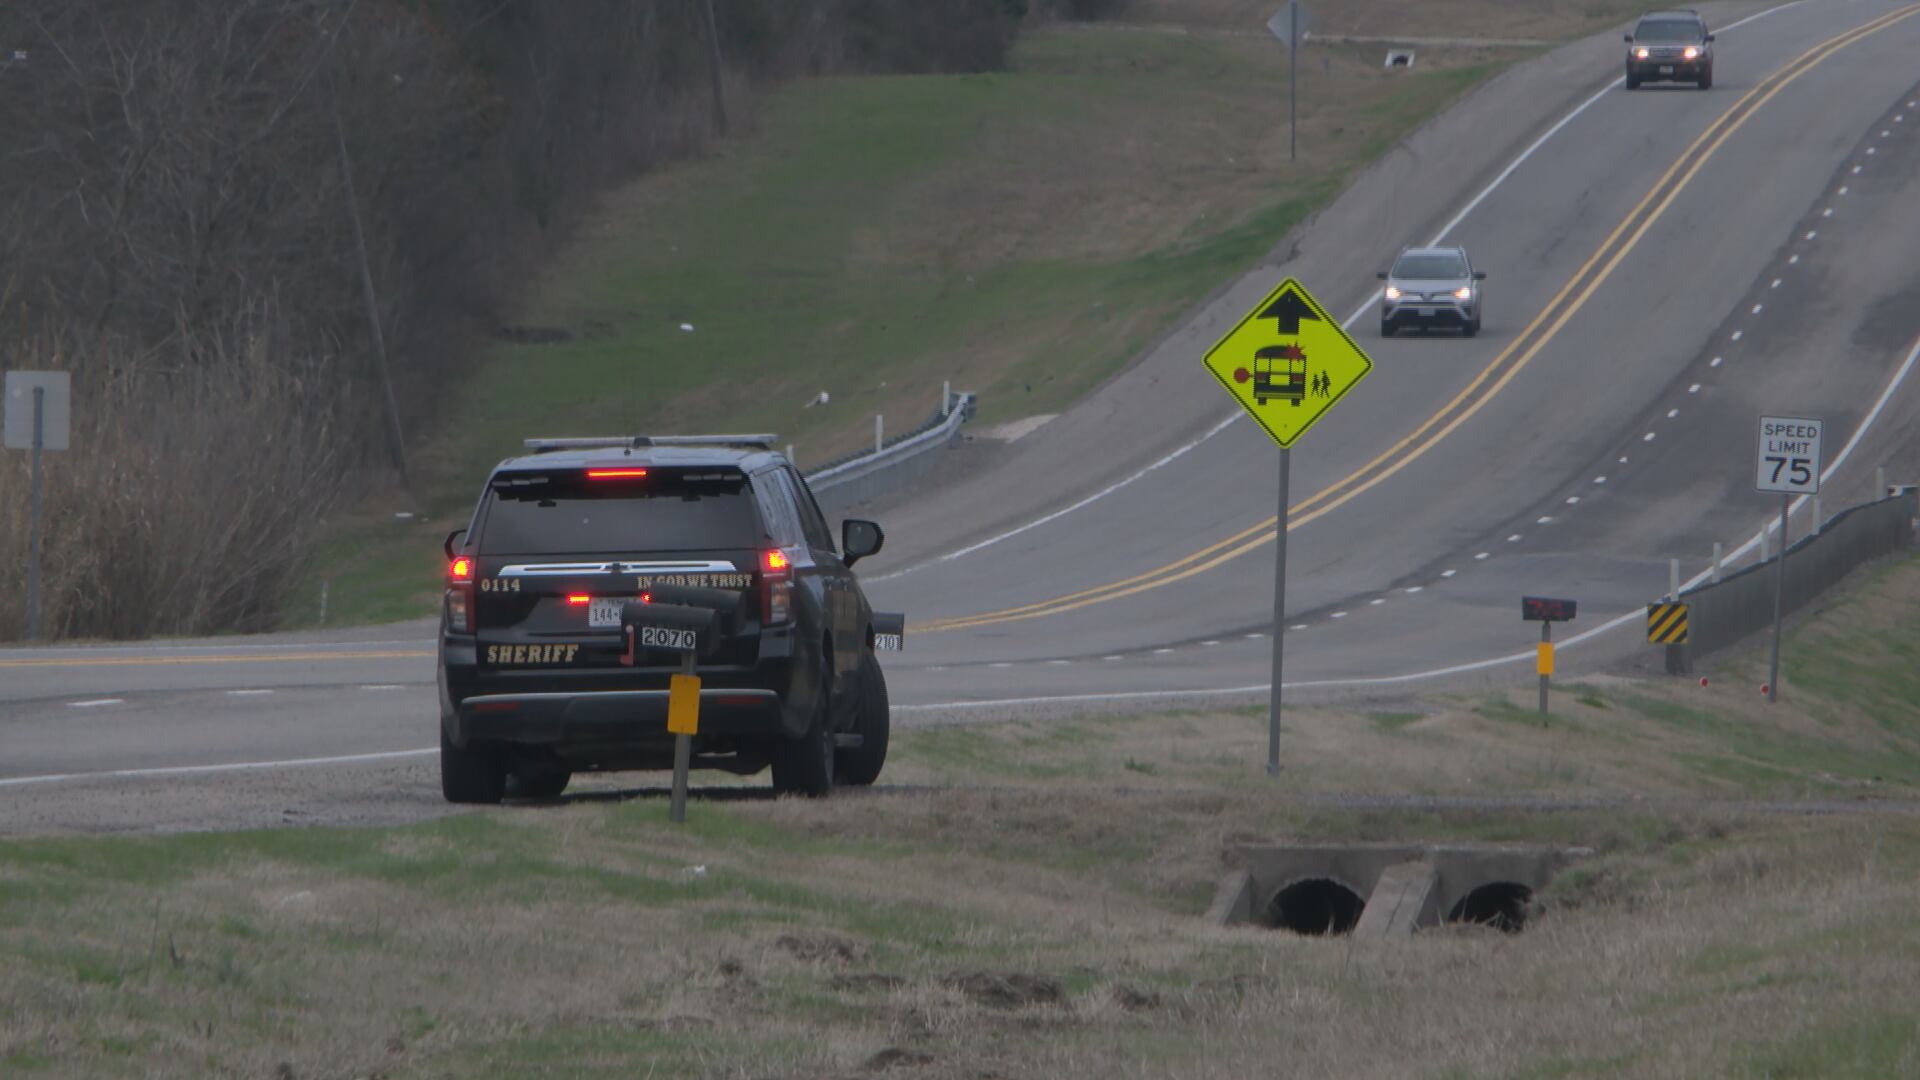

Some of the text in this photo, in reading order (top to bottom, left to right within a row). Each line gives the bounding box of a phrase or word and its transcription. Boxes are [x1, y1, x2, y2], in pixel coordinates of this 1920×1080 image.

[1764, 423, 1817, 438] SPEED
[1768, 440, 1811, 454] LIMIT
[1765, 456, 1812, 486] 75
[481, 578, 521, 592] 0114
[637, 575, 653, 589] IN
[711, 574, 753, 588] TRUST
[643, 627, 696, 648] 2070
[487, 644, 580, 664] SHERIFF
